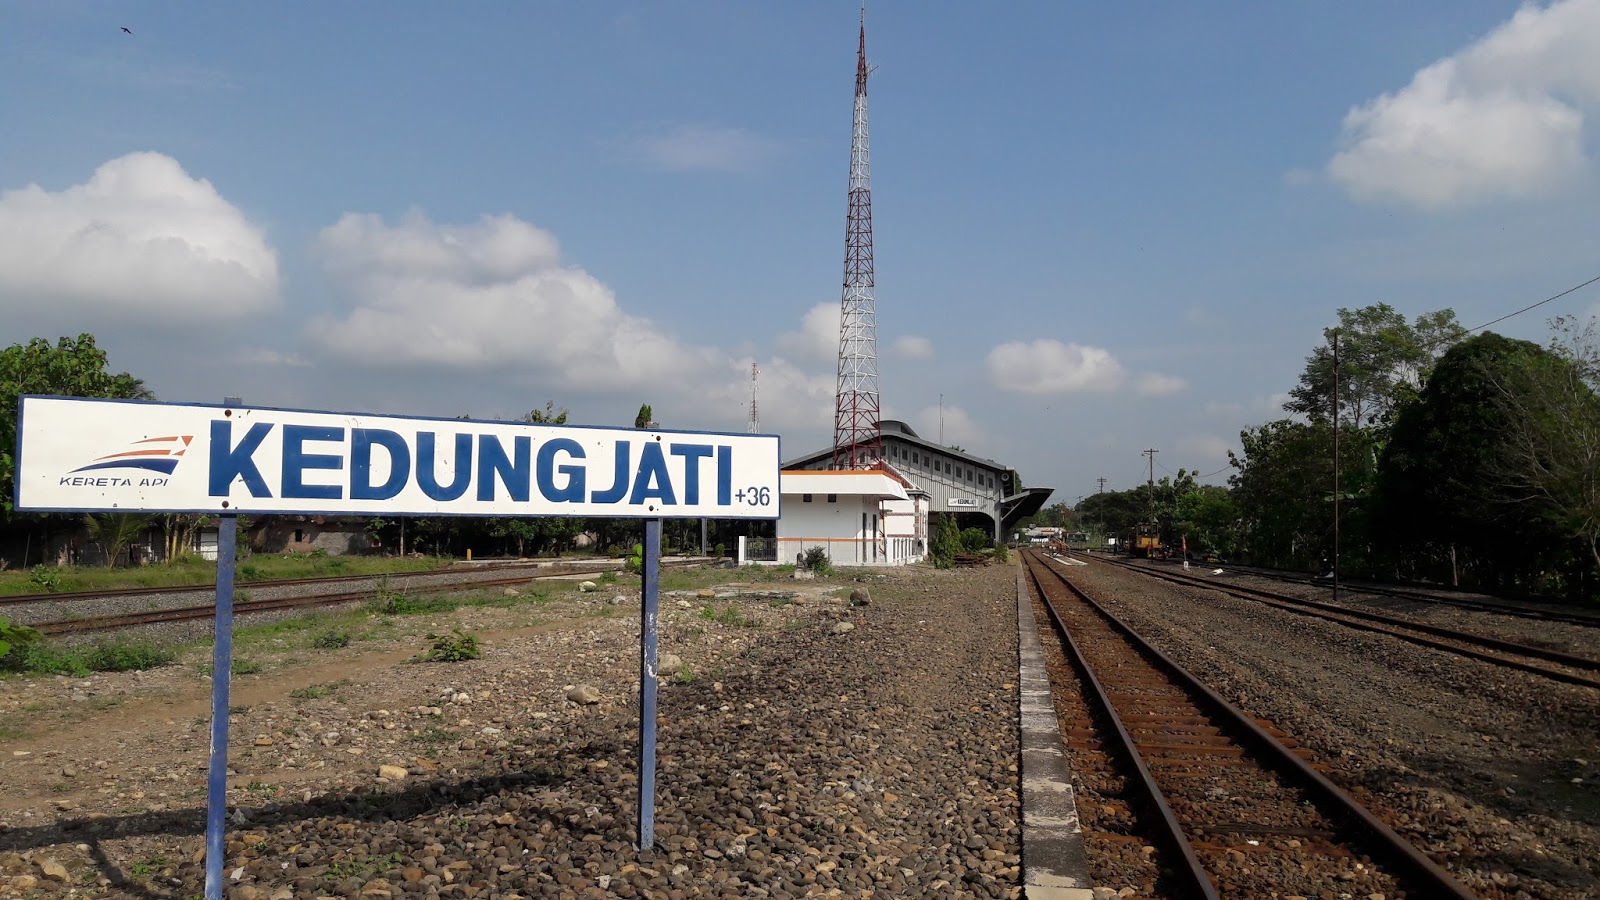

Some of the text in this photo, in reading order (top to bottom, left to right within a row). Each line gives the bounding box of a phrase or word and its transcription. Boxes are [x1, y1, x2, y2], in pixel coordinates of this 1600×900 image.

[208, 419, 732, 506] KEDUNGJATI
[59, 477, 168, 487] KERETA API
[734, 486, 770, 506] +36
